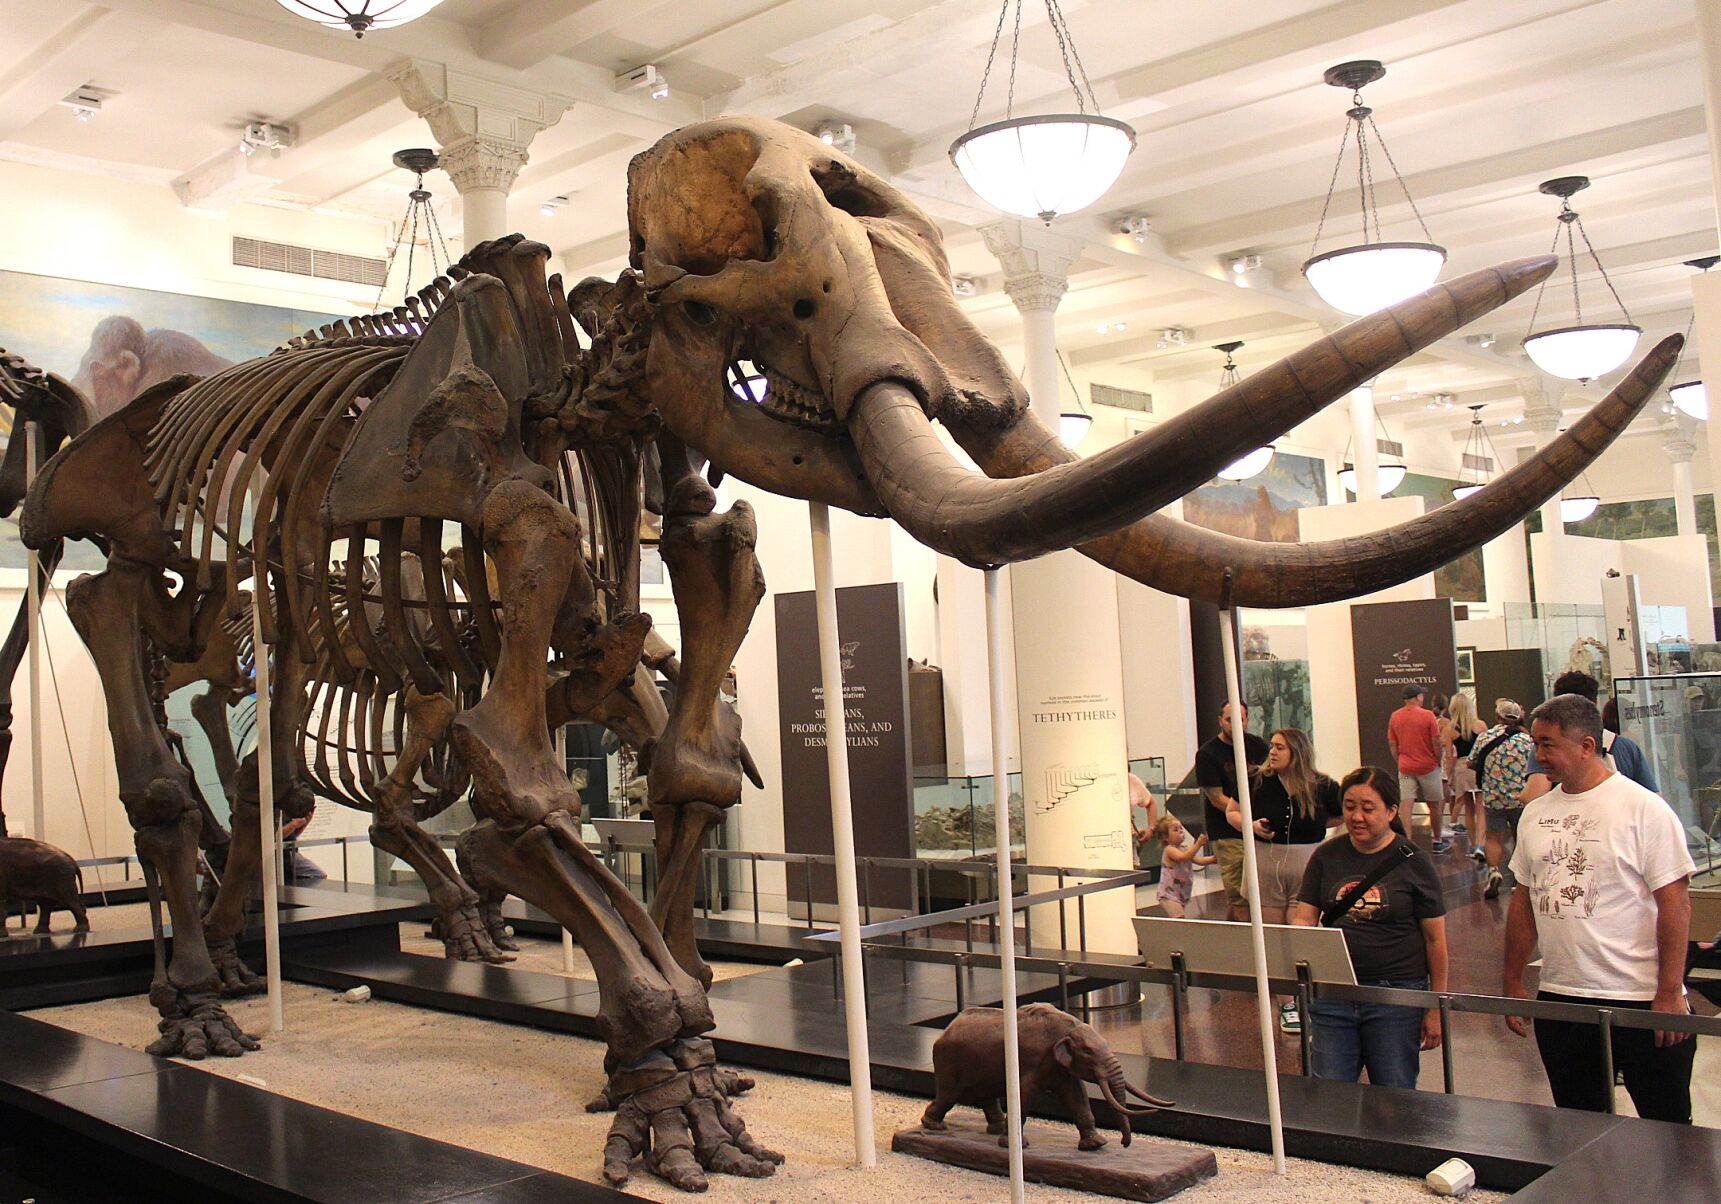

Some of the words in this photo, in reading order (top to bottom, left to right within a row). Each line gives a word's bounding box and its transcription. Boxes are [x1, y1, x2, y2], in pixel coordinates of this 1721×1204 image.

[1374, 676, 1437, 685] PERISSODACTYLS
[1032, 710, 1117, 723] TETHYTHERES
[871, 722, 892, 732] AND
